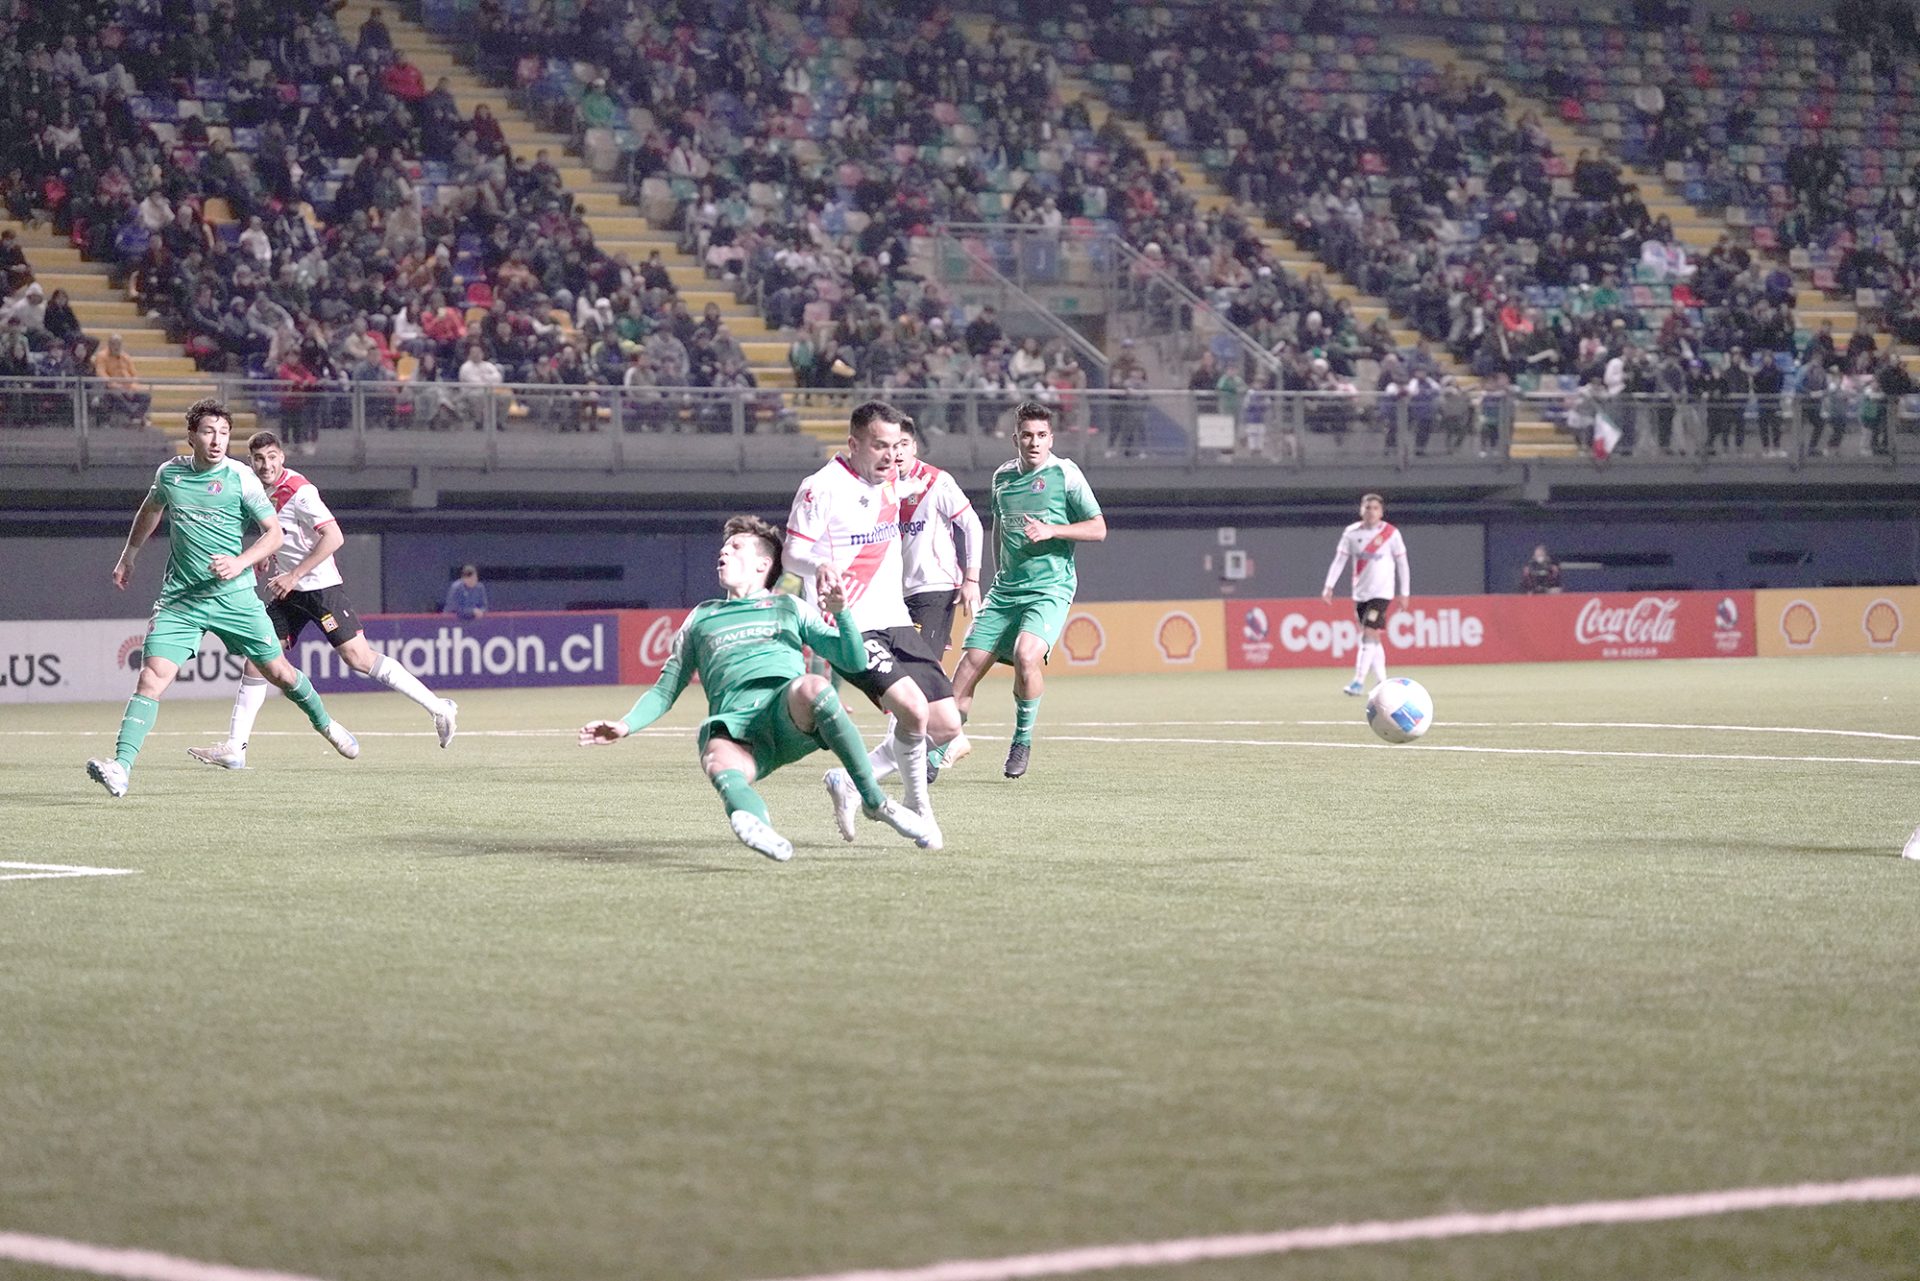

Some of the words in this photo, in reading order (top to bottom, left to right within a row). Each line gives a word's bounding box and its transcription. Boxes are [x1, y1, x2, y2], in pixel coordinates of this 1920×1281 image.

[1280, 613, 1362, 658] Cop
[1387, 608, 1484, 648] Chile
[0, 654, 61, 687] US
